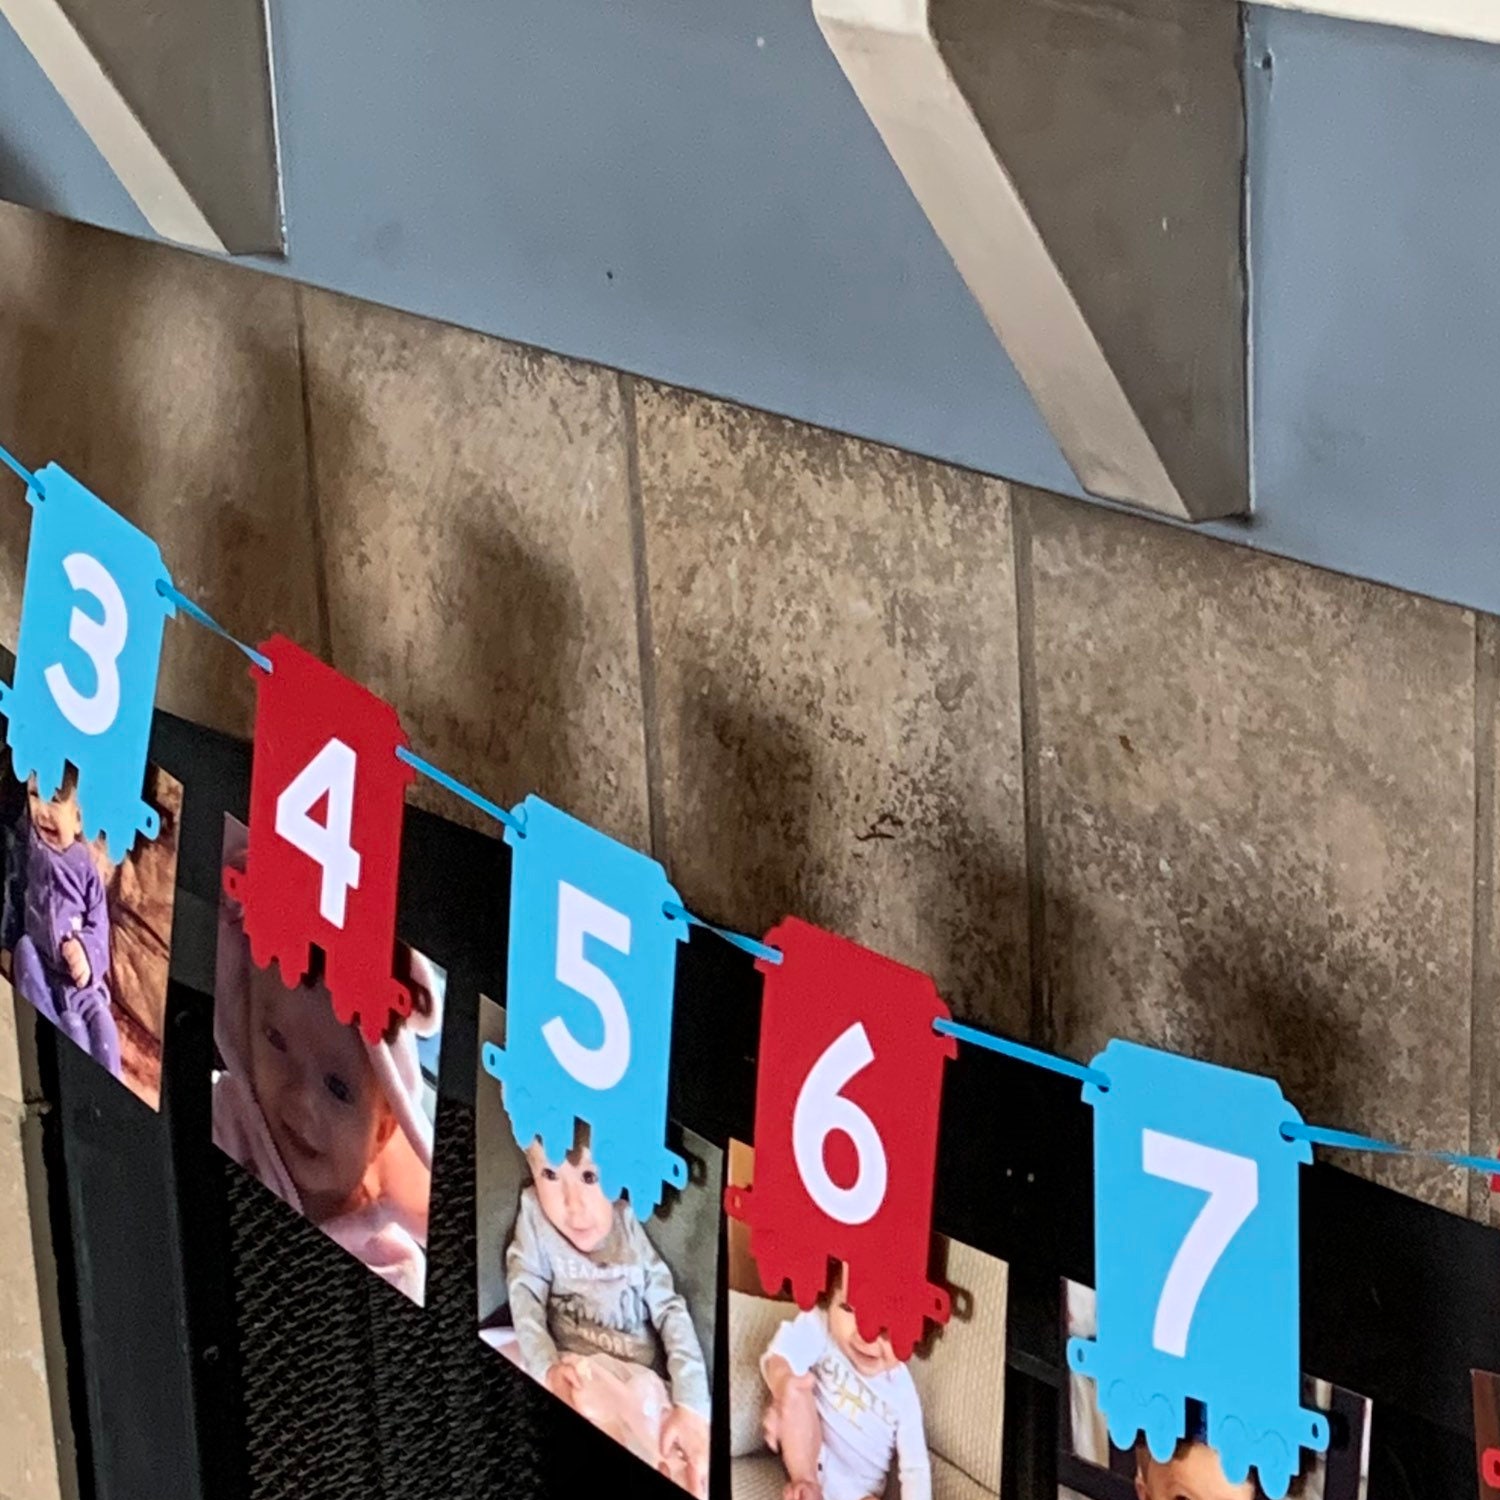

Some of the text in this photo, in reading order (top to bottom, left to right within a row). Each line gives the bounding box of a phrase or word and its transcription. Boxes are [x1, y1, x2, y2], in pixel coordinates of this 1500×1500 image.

[44, 552, 127, 735] 3
[275, 737, 361, 929] 4
[541, 880, 631, 1090] 5
[792, 1022, 887, 1225] 6
[1141, 1128, 1259, 1358] 7
